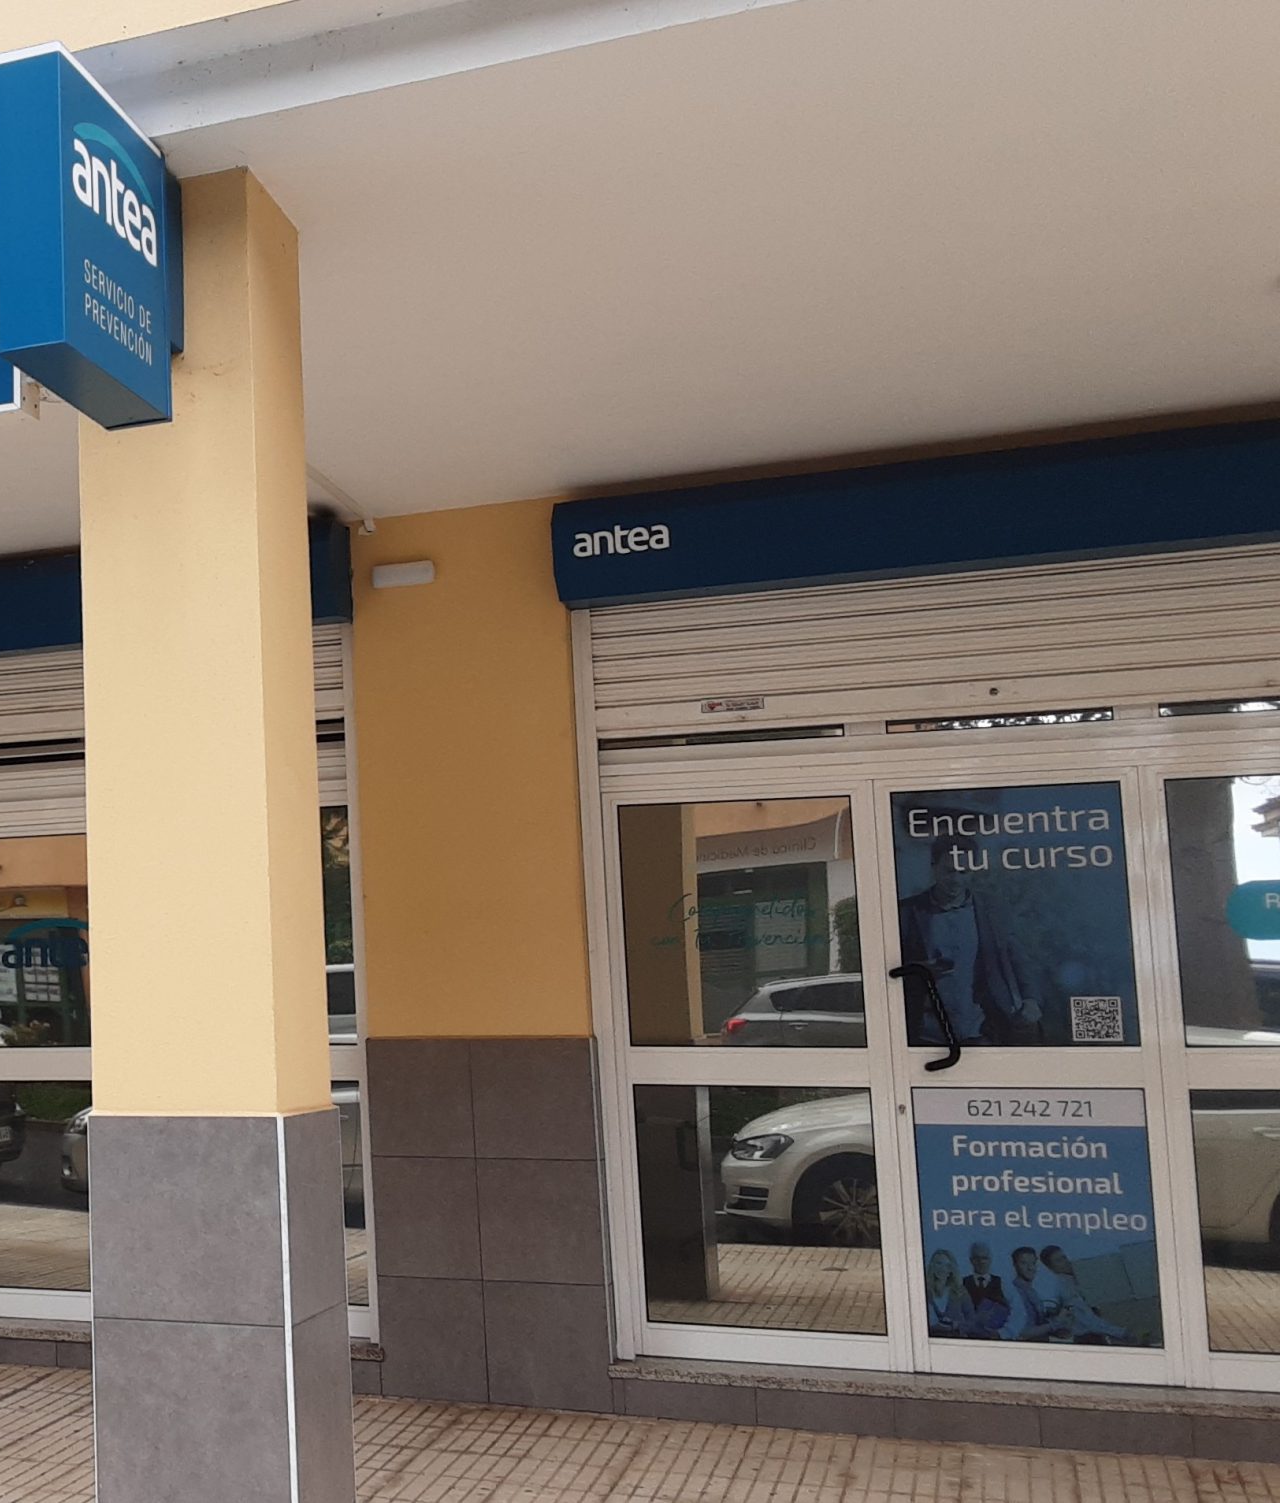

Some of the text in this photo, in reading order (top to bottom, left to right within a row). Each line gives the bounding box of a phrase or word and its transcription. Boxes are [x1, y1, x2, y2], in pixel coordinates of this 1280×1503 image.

[72, 138, 157, 267] antea
[83, 258, 153, 334] SERVICIO DE
[84, 302, 153, 365] PREVENCIÓN
[573, 524, 670, 557] antea
[908, 805, 1110, 838] Encuentra
[949, 844, 1113, 872] tu curso
[967, 1099, 1094, 1118] 621 242 721
[952, 1135, 1108, 1159] Formación
[952, 1170, 1124, 1197] profesional
[932, 1206, 1148, 1235] para el empleo
